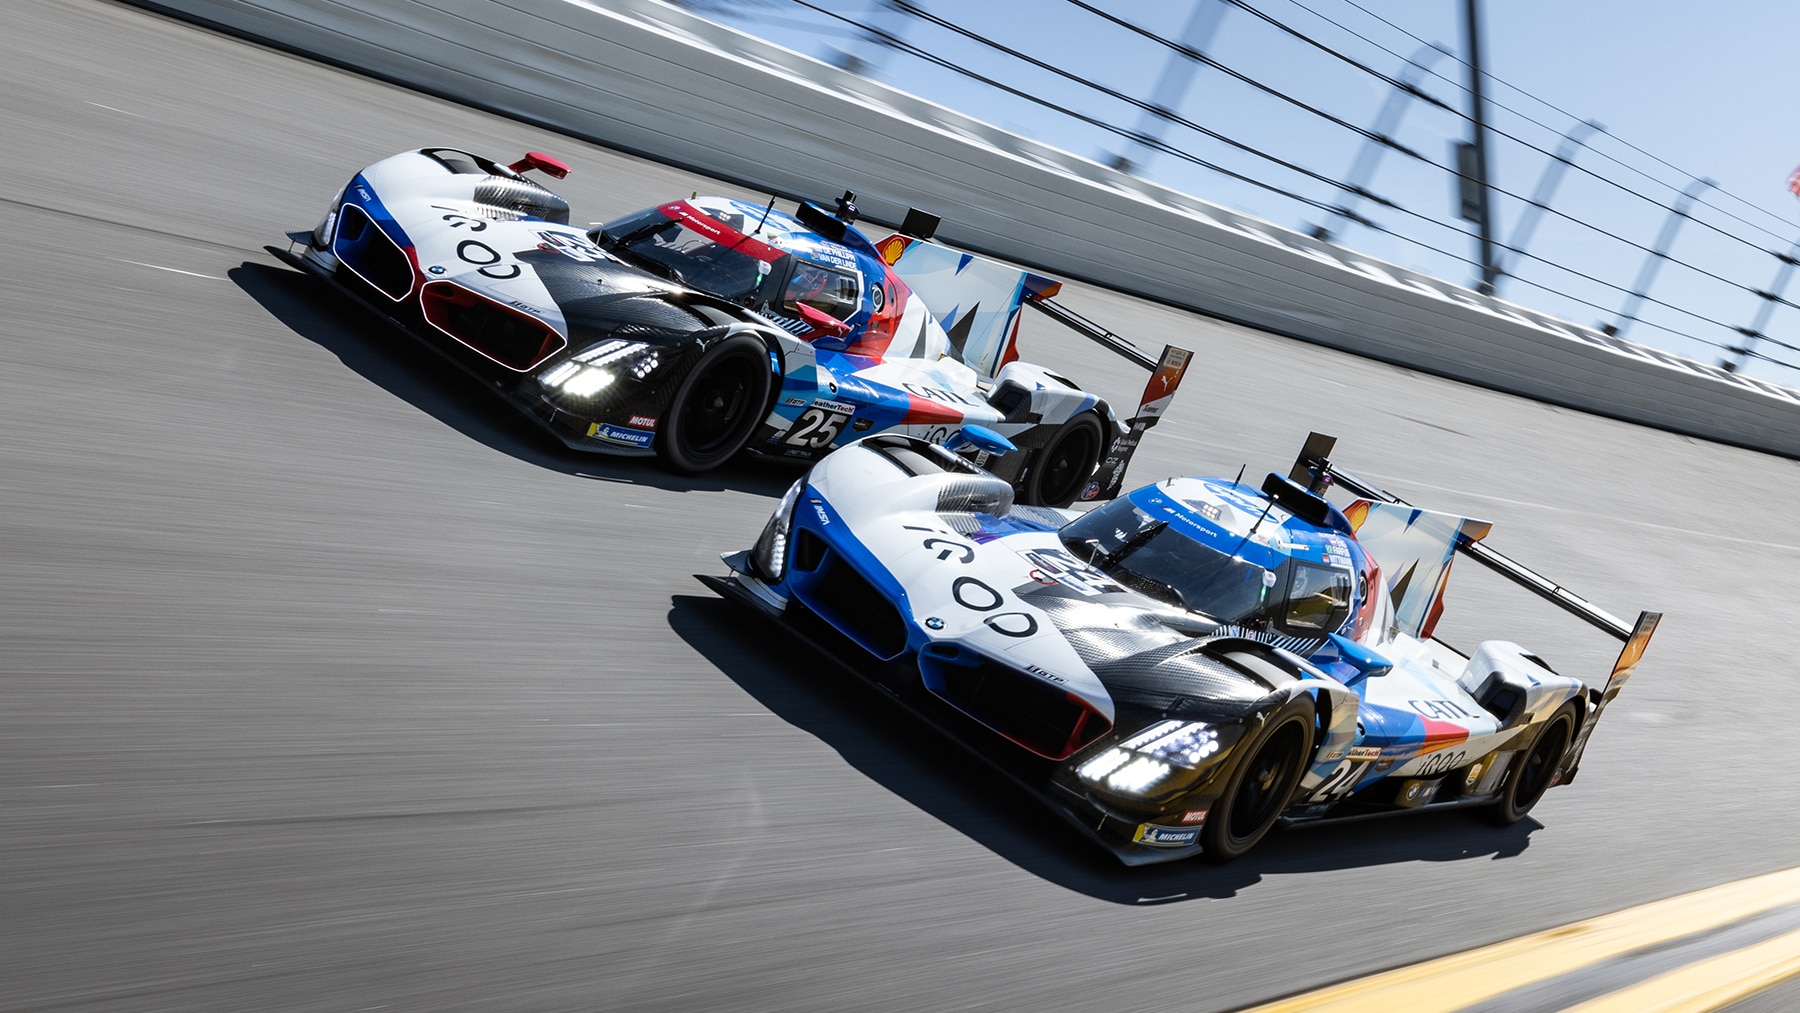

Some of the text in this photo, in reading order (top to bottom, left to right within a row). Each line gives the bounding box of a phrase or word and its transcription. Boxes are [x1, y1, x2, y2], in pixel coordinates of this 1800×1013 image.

[686, 215, 721, 235] Motorsport
[901, 382, 980, 407] CATL
[812, 399, 854, 413] eatherTech
[629, 416, 656, 427] MOTUL
[785, 409, 848, 449] 25
[610, 431, 649, 443] MICHELIN
[1174, 513, 1219, 538] Motorsport
[1407, 699, 1480, 720] CATL
[1307, 759, 1371, 802] 24
[1183, 811, 1207, 822] MOTUL
[1158, 832, 1196, 841] MICHELIN
